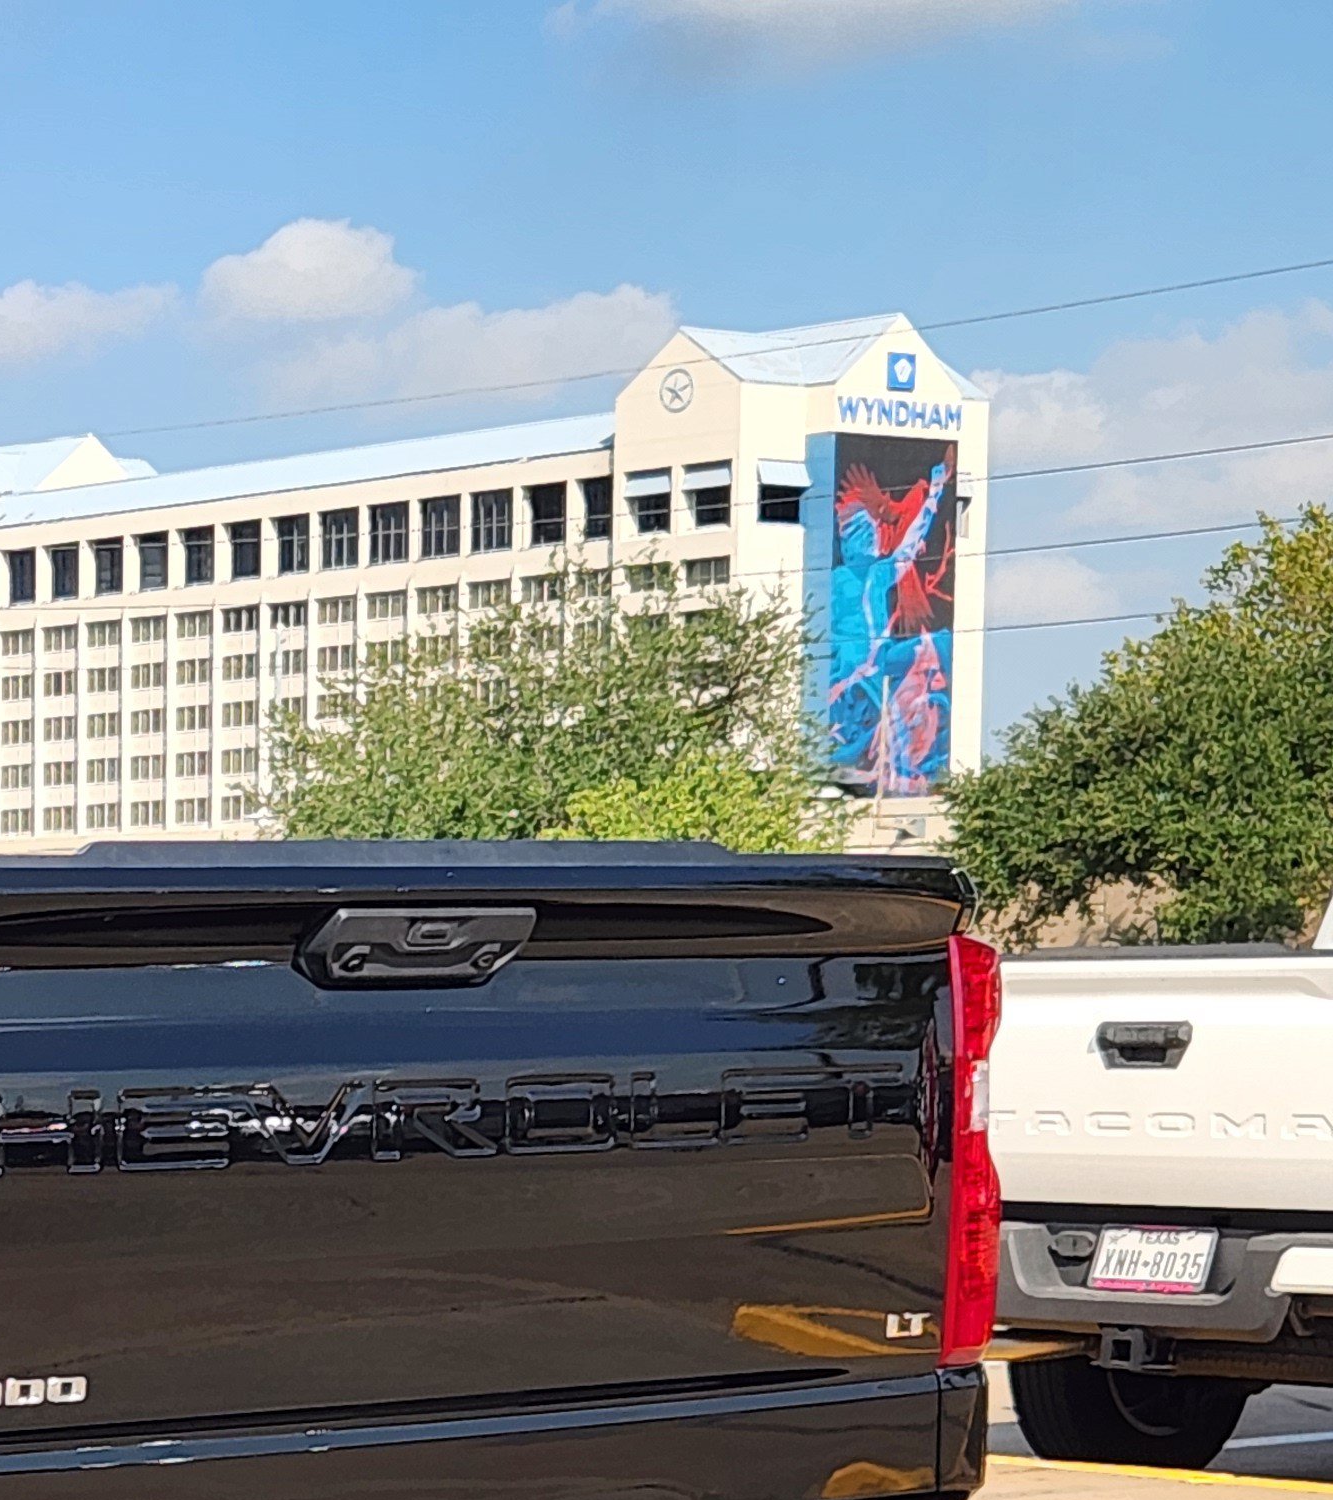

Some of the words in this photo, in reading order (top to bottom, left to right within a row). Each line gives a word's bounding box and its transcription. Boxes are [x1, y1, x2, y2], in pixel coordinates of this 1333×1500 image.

[837, 396, 963, 432] WYNDHAM
[987, 1110, 1333, 1141] TACOMA
[885, 1311, 932, 1339] LT
